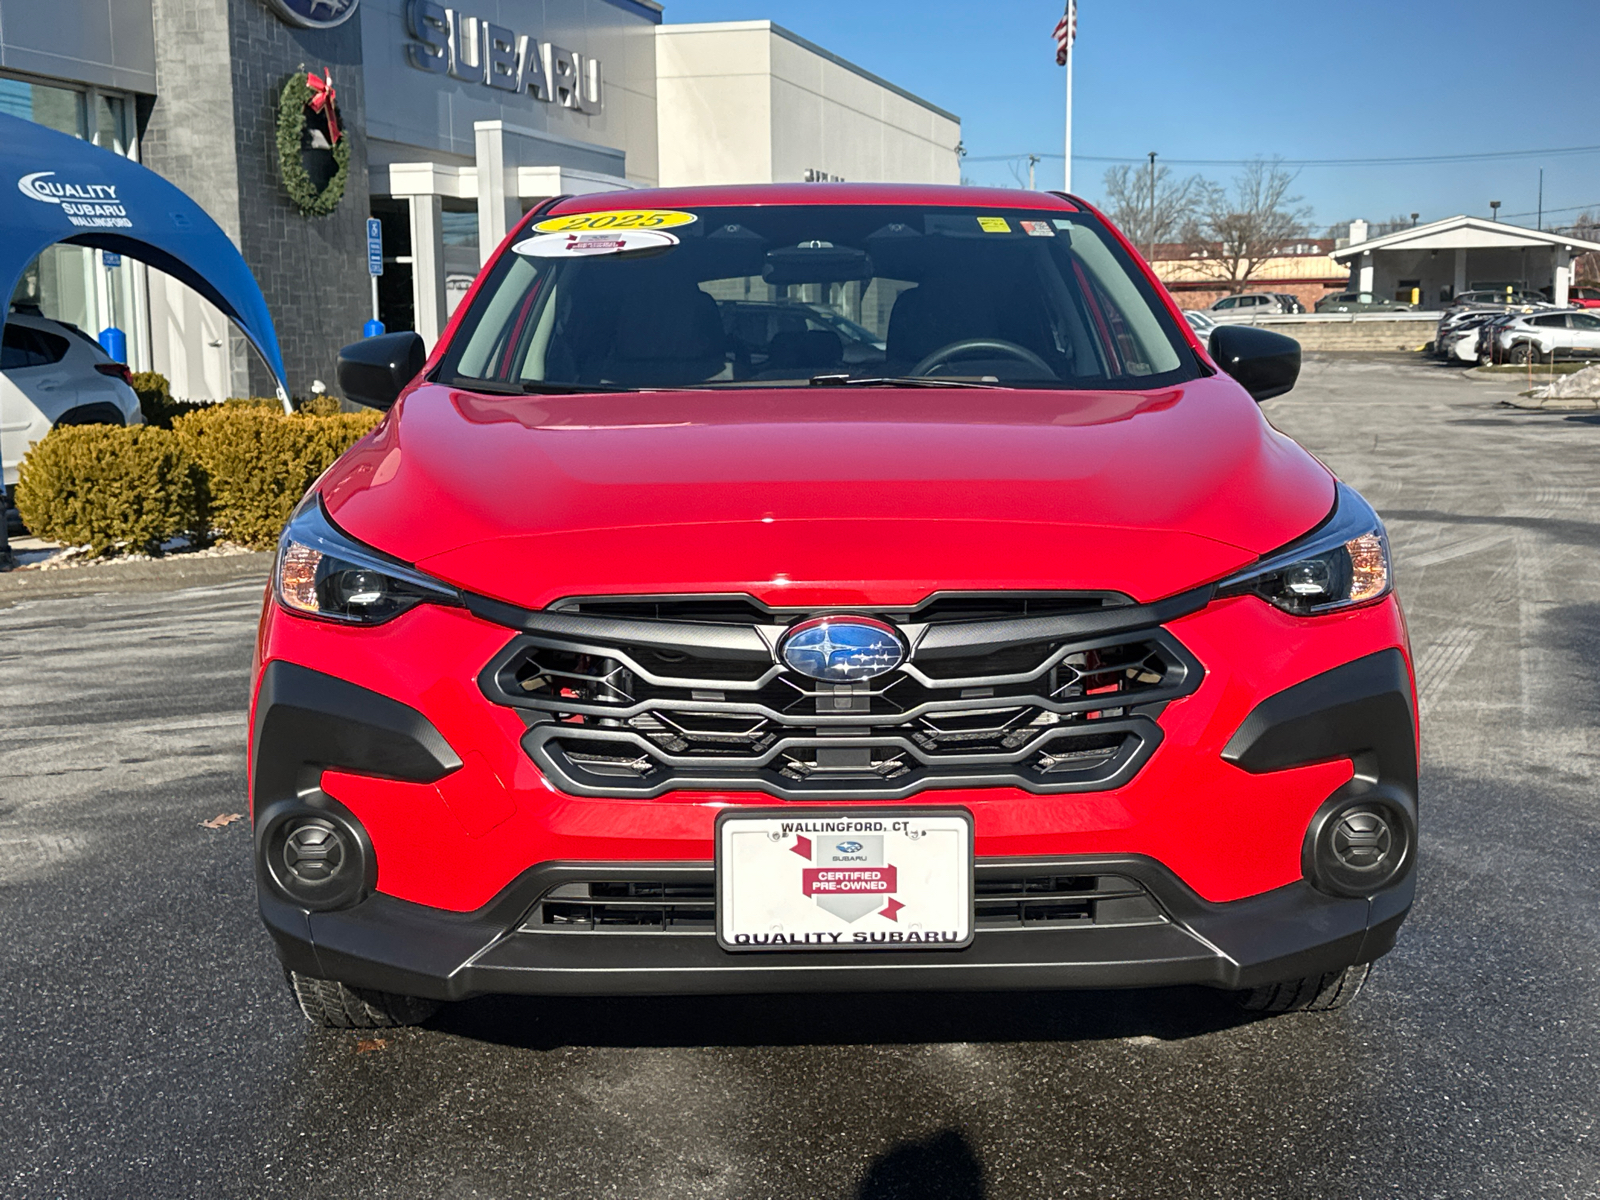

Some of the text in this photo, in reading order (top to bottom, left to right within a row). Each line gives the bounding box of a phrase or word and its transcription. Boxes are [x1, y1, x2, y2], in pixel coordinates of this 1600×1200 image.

[405, 0, 604, 115] SUBARU
[33, 180, 117, 199] QUALITY
[61, 202, 127, 217] SUBARU
[67, 216, 133, 228] WALLINGFORD
[558, 213, 673, 231] 2025
[781, 821, 910, 833] WALLINGFORD, CT
[818, 871, 881, 881] CERTIFIED
[812, 880, 888, 890] PRE-OWNED
[734, 930, 958, 944] QUALITY SUBARU
